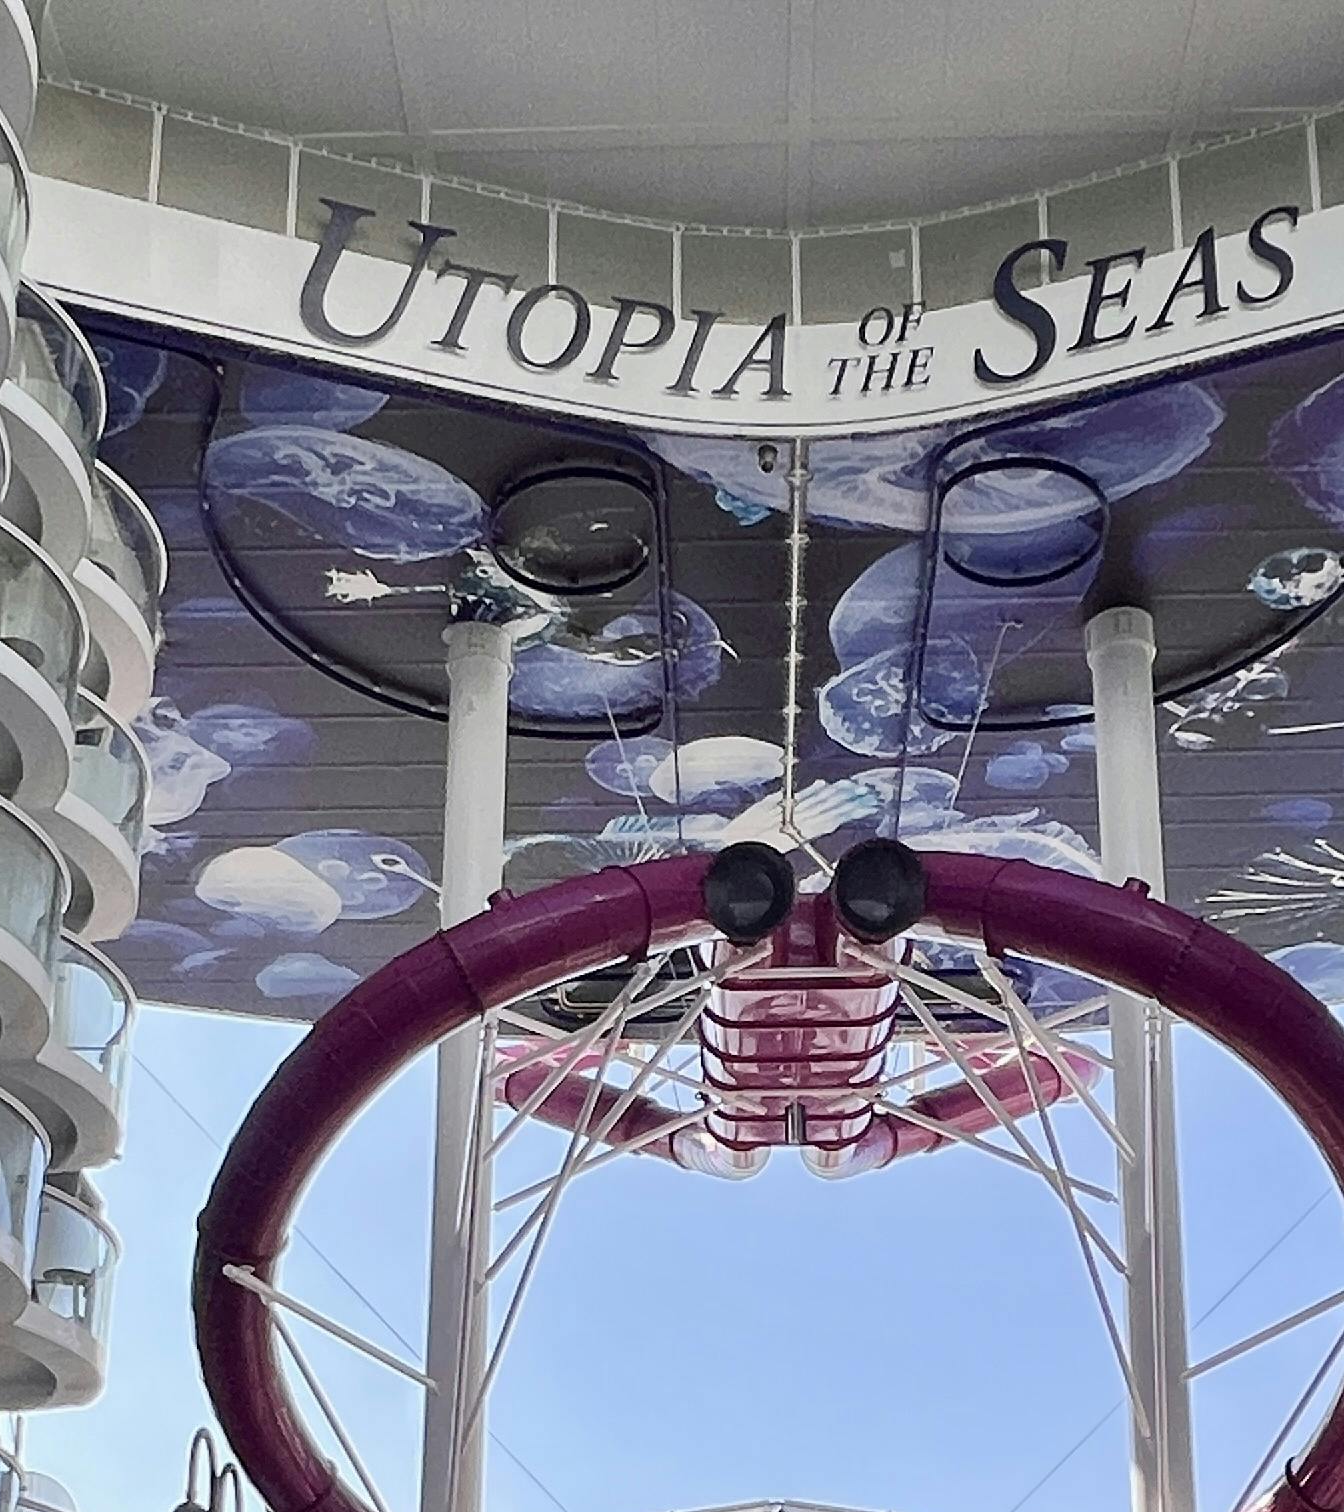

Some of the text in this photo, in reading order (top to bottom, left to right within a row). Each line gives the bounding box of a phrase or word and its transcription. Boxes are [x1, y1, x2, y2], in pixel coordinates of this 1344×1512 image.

[299, 198, 1300, 400] UTOPIA OF THE SEAS
